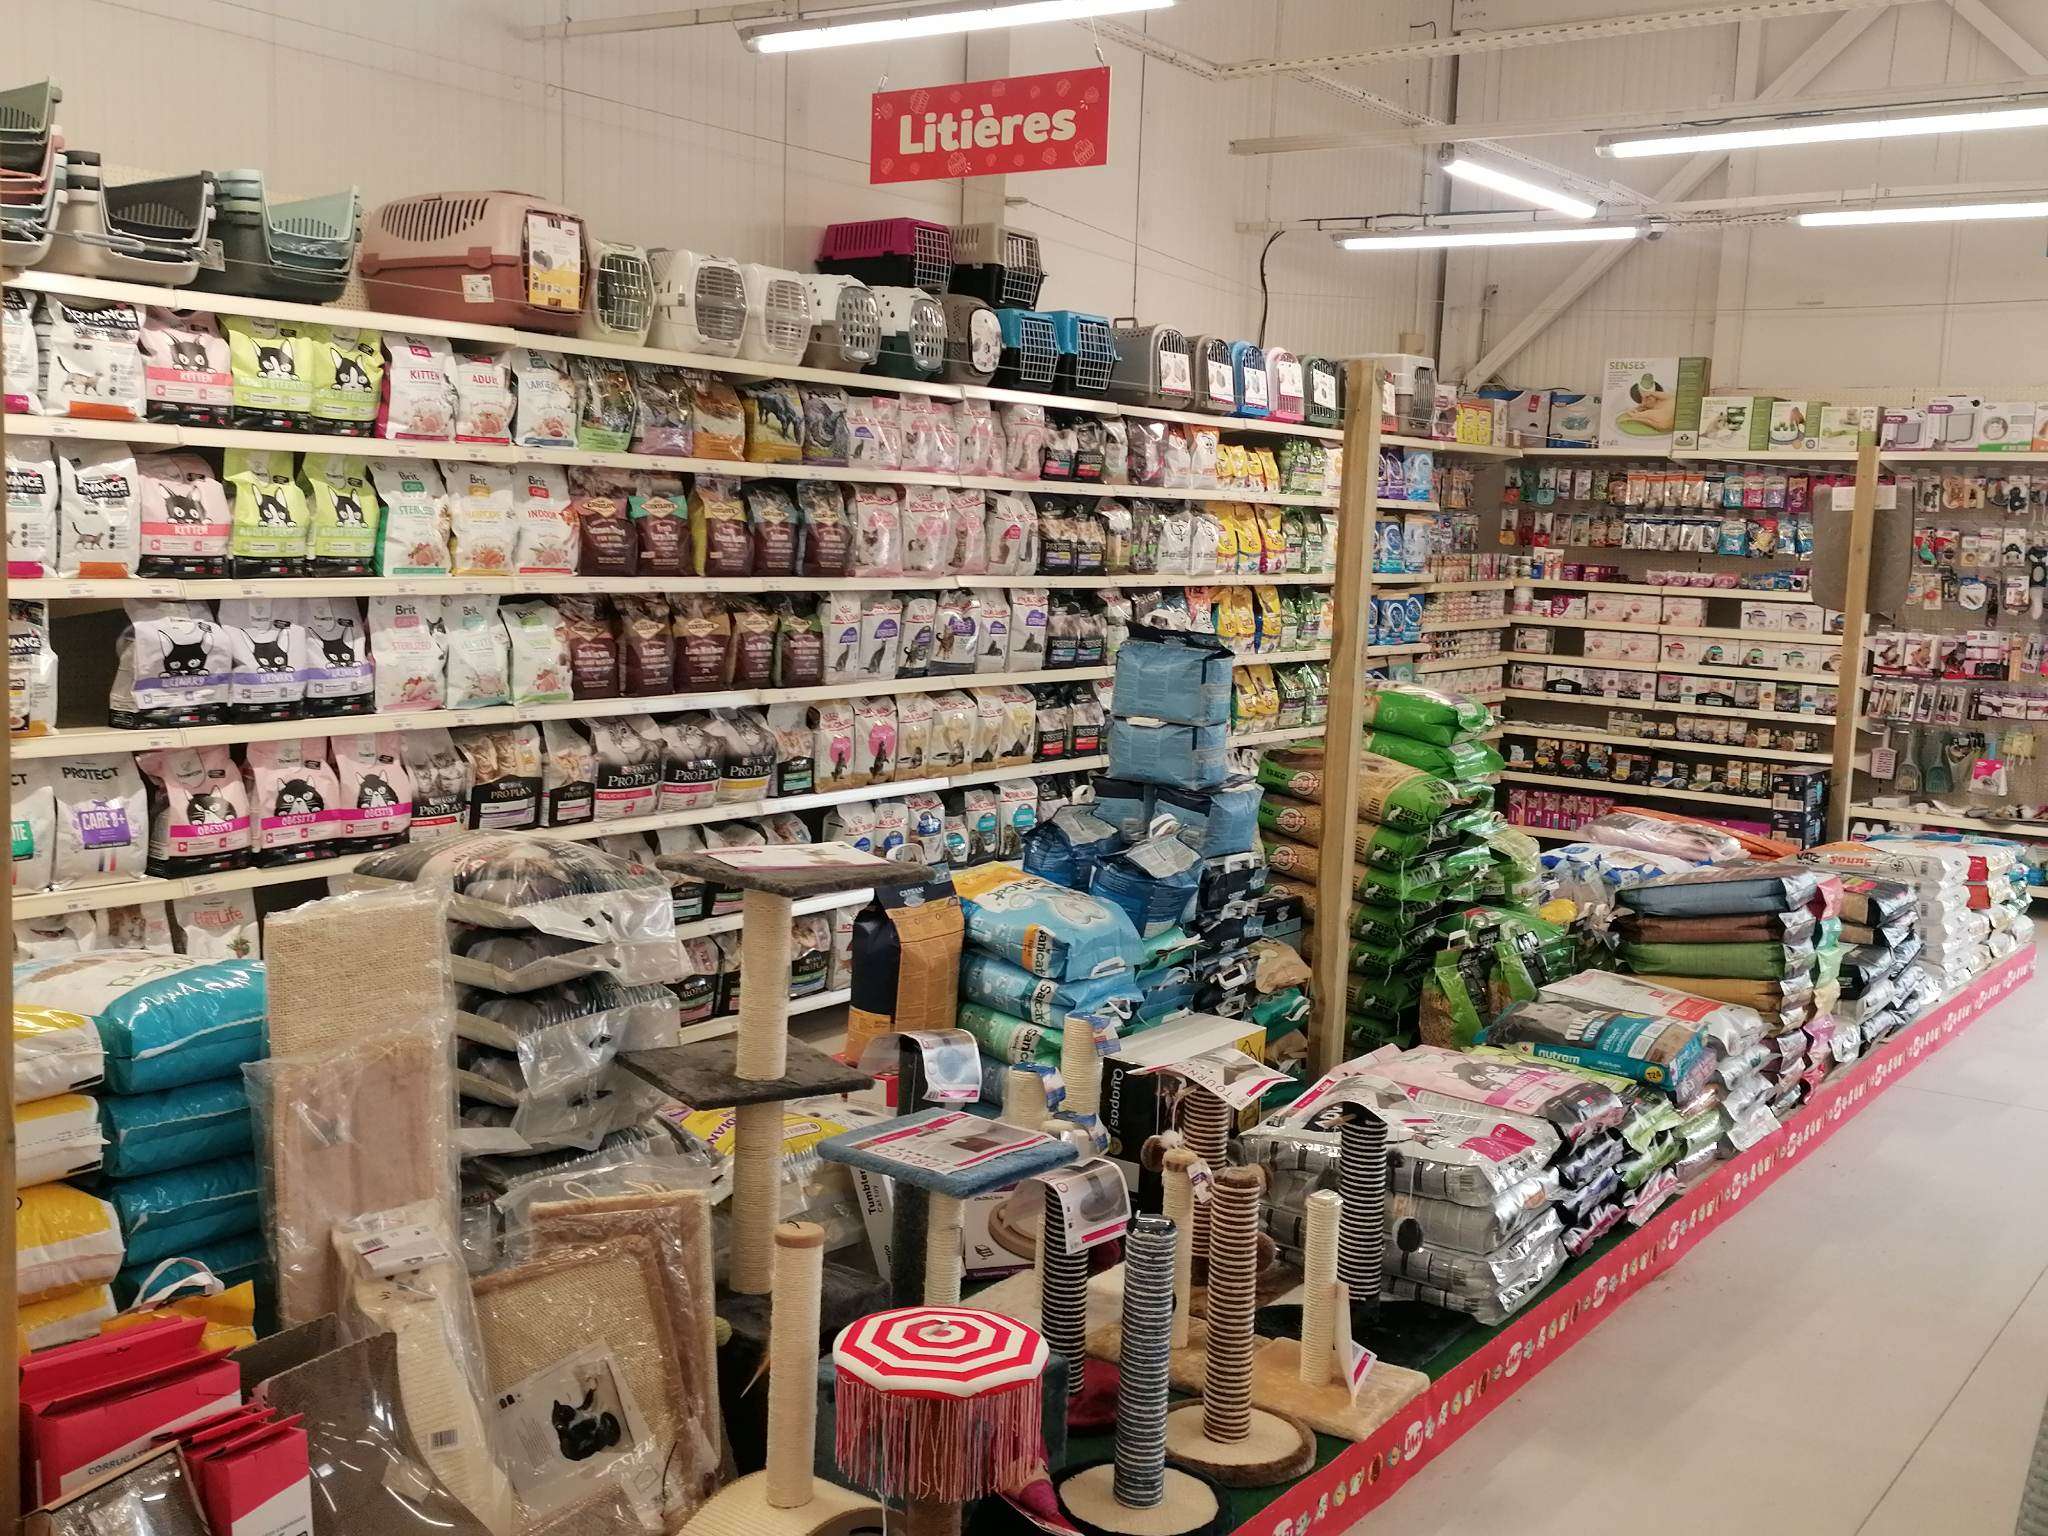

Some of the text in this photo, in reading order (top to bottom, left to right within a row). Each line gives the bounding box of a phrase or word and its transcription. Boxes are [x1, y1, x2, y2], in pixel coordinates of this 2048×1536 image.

[900, 104, 1077, 156] Litières
[1608, 361, 1646, 370] SENSES
[7, 474, 44, 488] VANCE
[394, 604, 417, 616] Brit
[9, 635, 41, 650] VANCE
[62, 766, 119, 780] PROTECT
[608, 773, 632, 787] PRO
[674, 769, 698, 781] PRO
[419, 805, 441, 816] PRO
[81, 809, 127, 831] CARE 8+
[281, 813, 316, 826] OBESITY
[198, 822, 233, 836] OBESITY
[1033, 984, 1053, 1023] Sacat
[1020, 1028, 1040, 1062] Sanic
[1537, 1049, 1580, 1064] nutram
[859, 1169, 877, 1216] Tumbler
